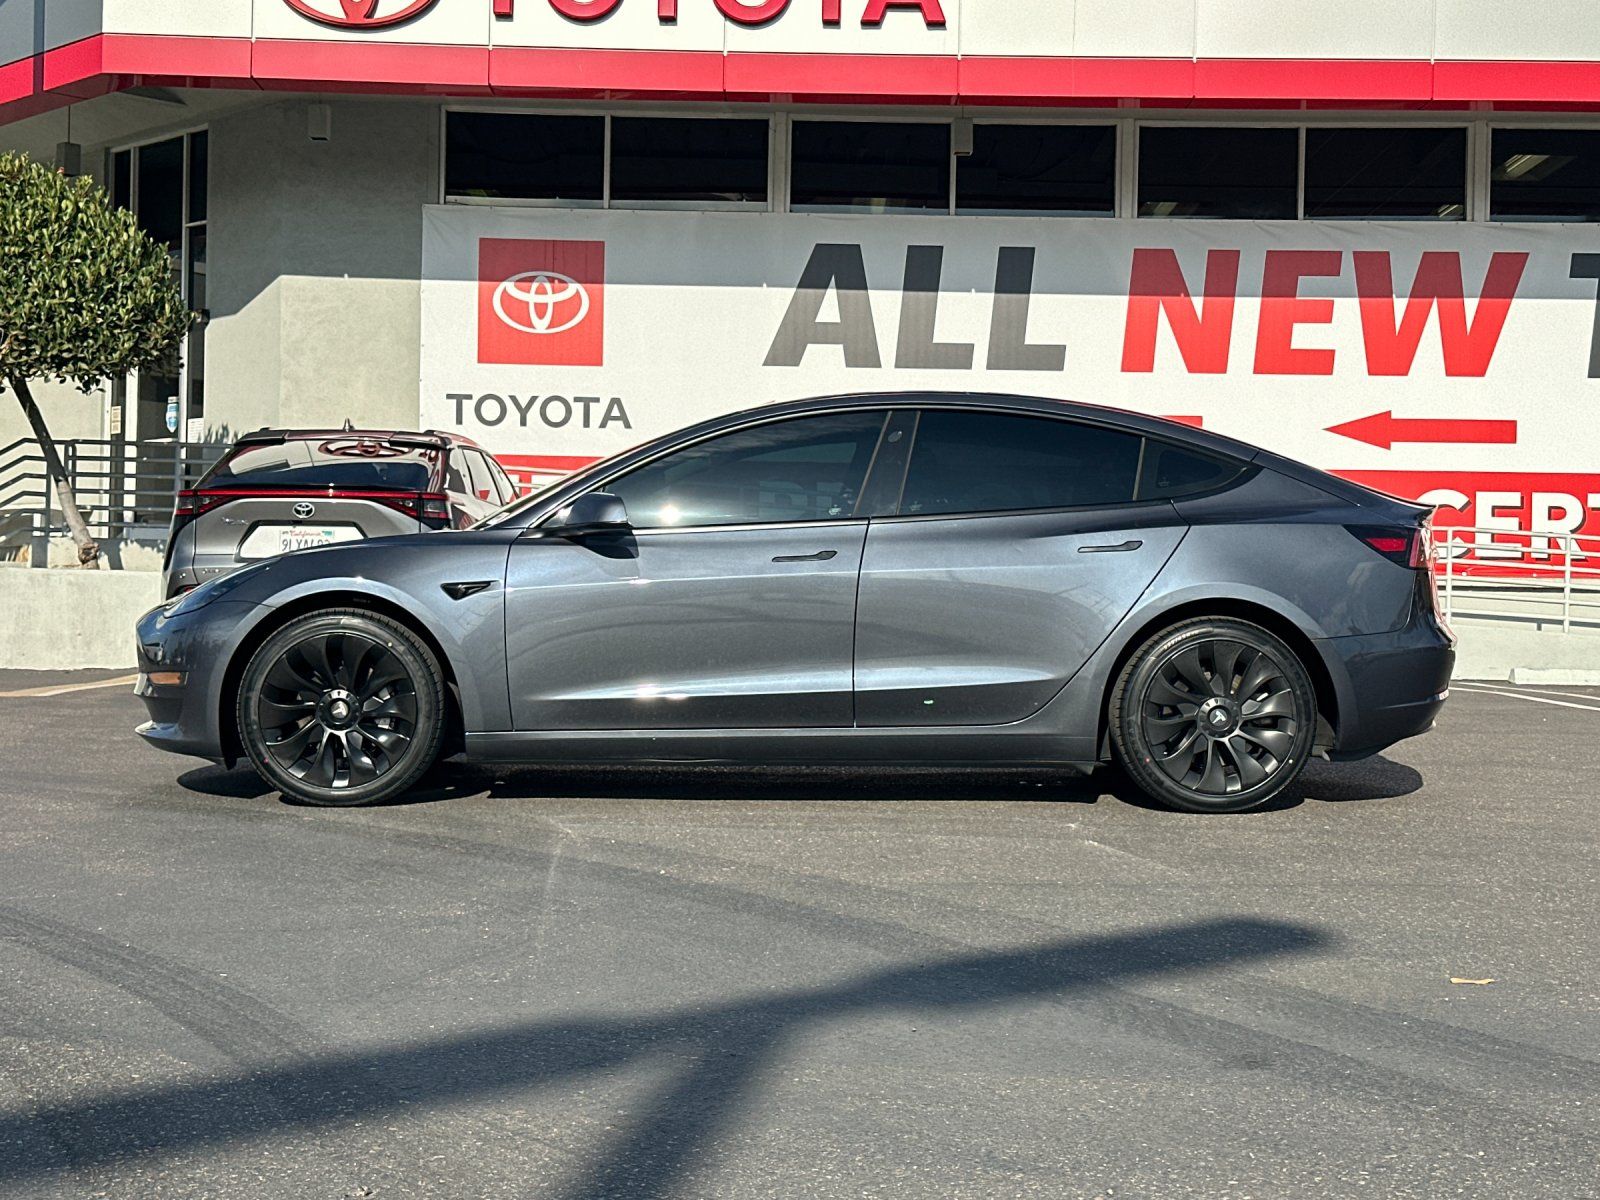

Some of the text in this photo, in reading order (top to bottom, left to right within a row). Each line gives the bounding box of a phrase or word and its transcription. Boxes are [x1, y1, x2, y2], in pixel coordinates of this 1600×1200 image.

[764, 243, 1066, 371] ALL
[1121, 249, 1529, 377] NEW
[445, 393, 633, 430] TOYOTA
[1416, 488, 1600, 561] CER
